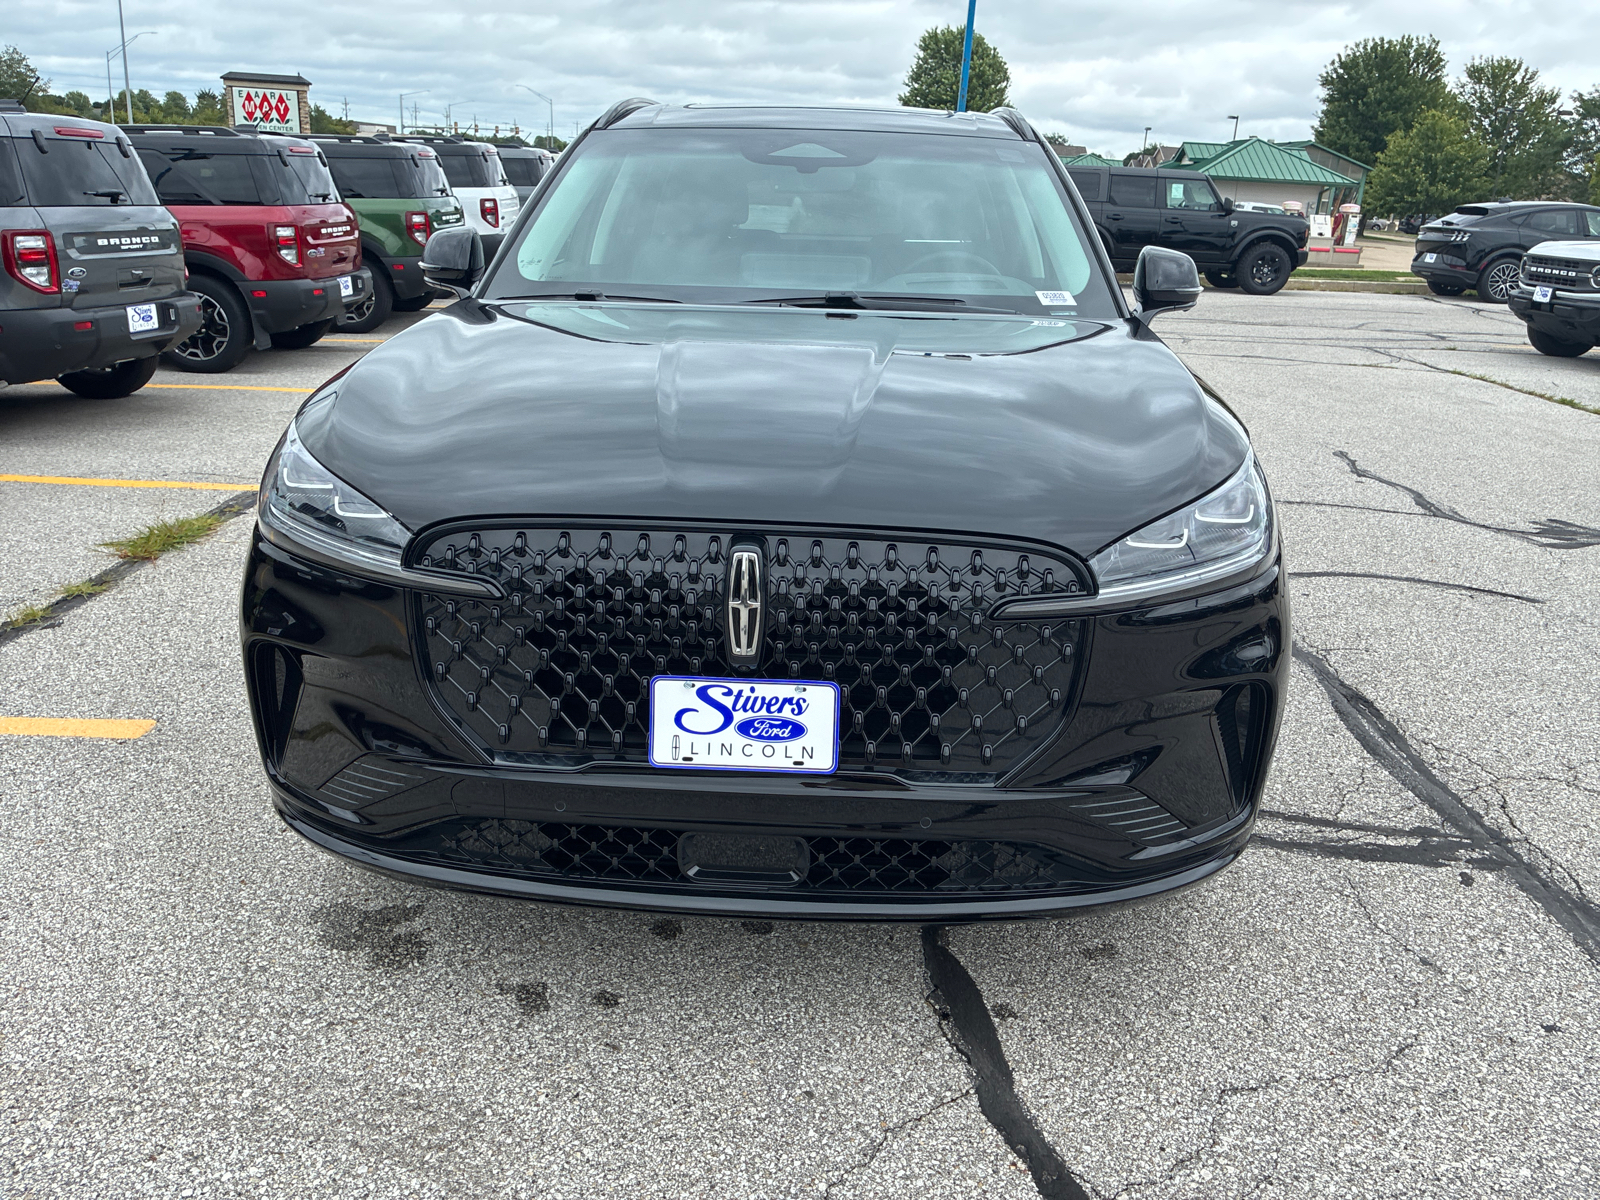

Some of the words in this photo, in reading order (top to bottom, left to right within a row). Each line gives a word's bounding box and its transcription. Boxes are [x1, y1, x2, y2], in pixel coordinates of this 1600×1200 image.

[238, 89, 292, 101] EARL
[244, 100, 286, 115] MAY
[268, 124, 294, 132] CENTER
[97, 236, 159, 246] BRONCO
[1530, 266, 1576, 277] BRONCO
[674, 684, 809, 735] Stivers
[750, 719, 793, 738] Ford
[690, 741, 814, 760] LINCOLN
